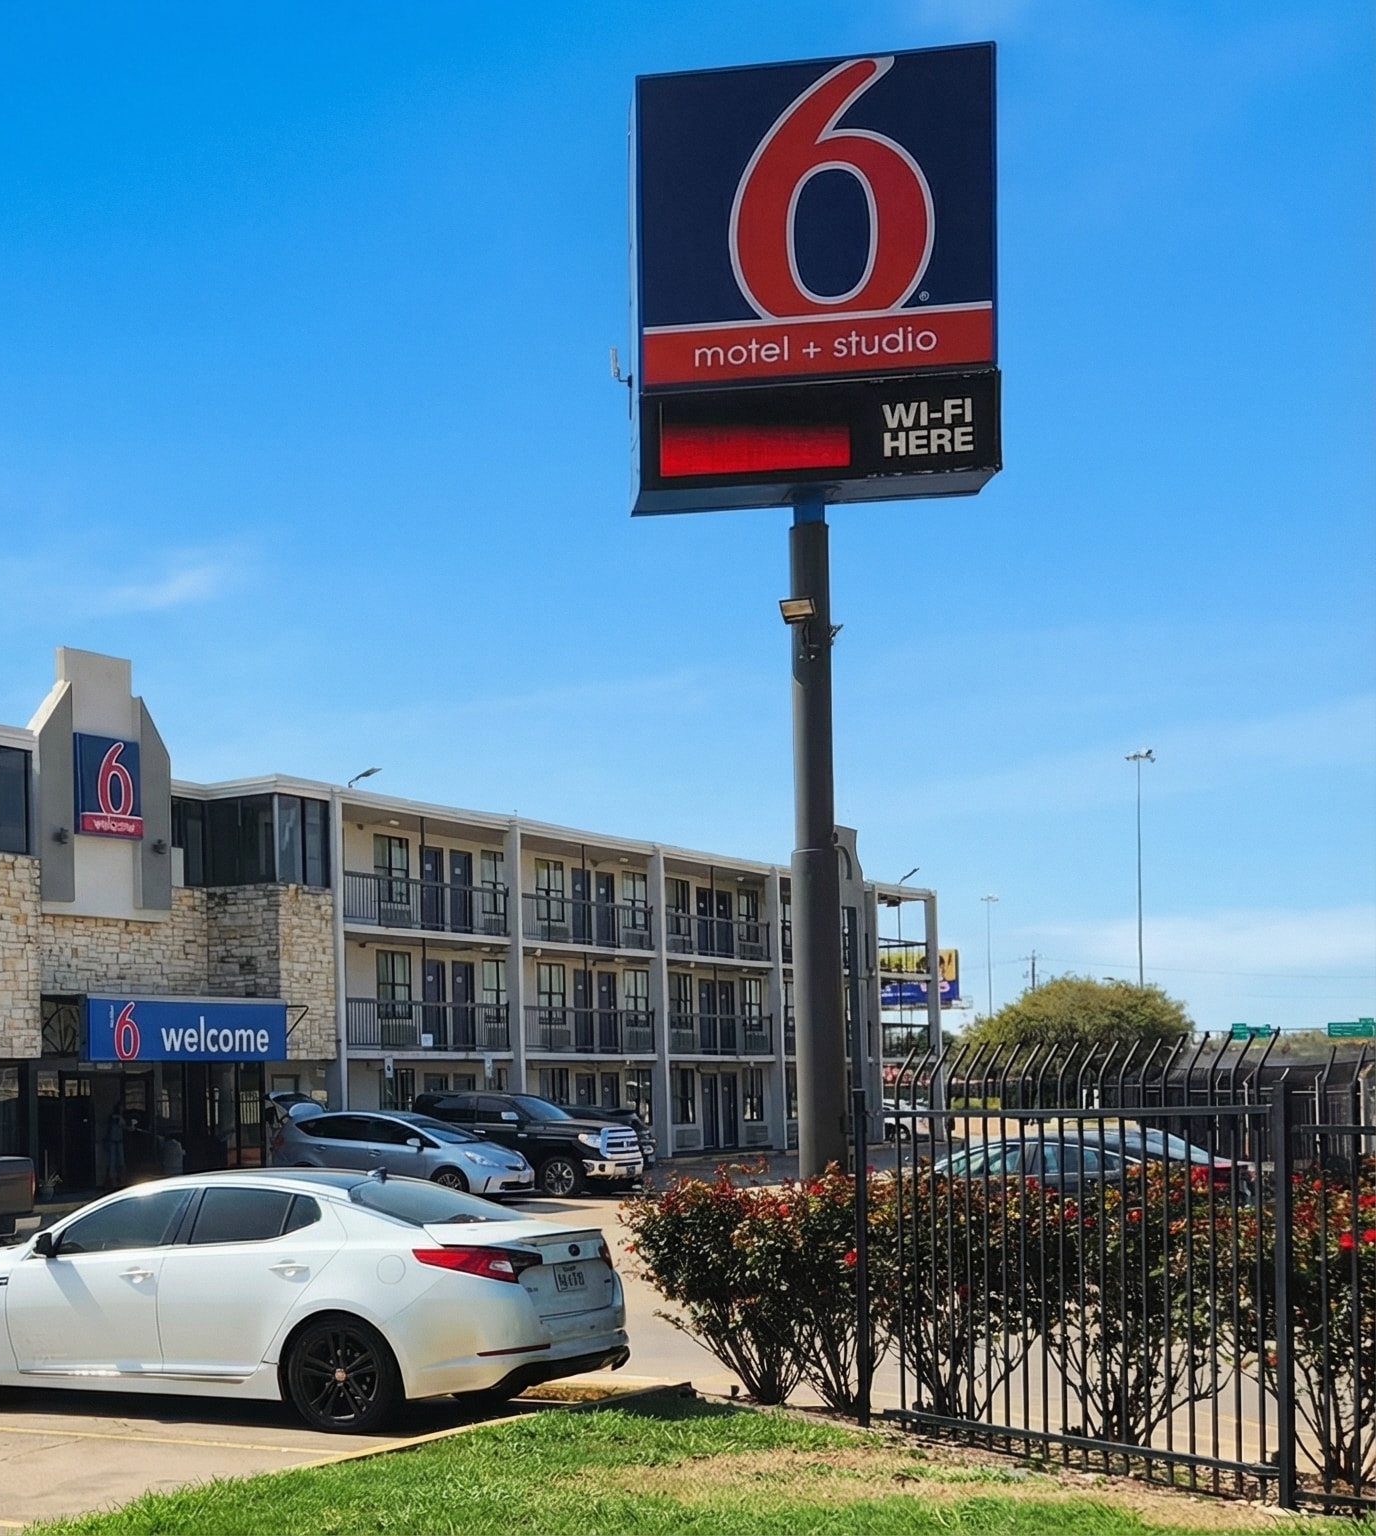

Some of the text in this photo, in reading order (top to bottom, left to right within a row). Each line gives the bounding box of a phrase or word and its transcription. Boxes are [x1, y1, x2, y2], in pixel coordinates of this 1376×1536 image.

[728, 55, 935, 320] 6
[694, 326, 938, 367] motel + studio
[882, 398, 973, 429] WI-FI
[883, 426, 974, 457] HERE
[97, 742, 134, 816] 6
[114, 1001, 140, 1060] 6
[161, 1015, 269, 1053] welcome
